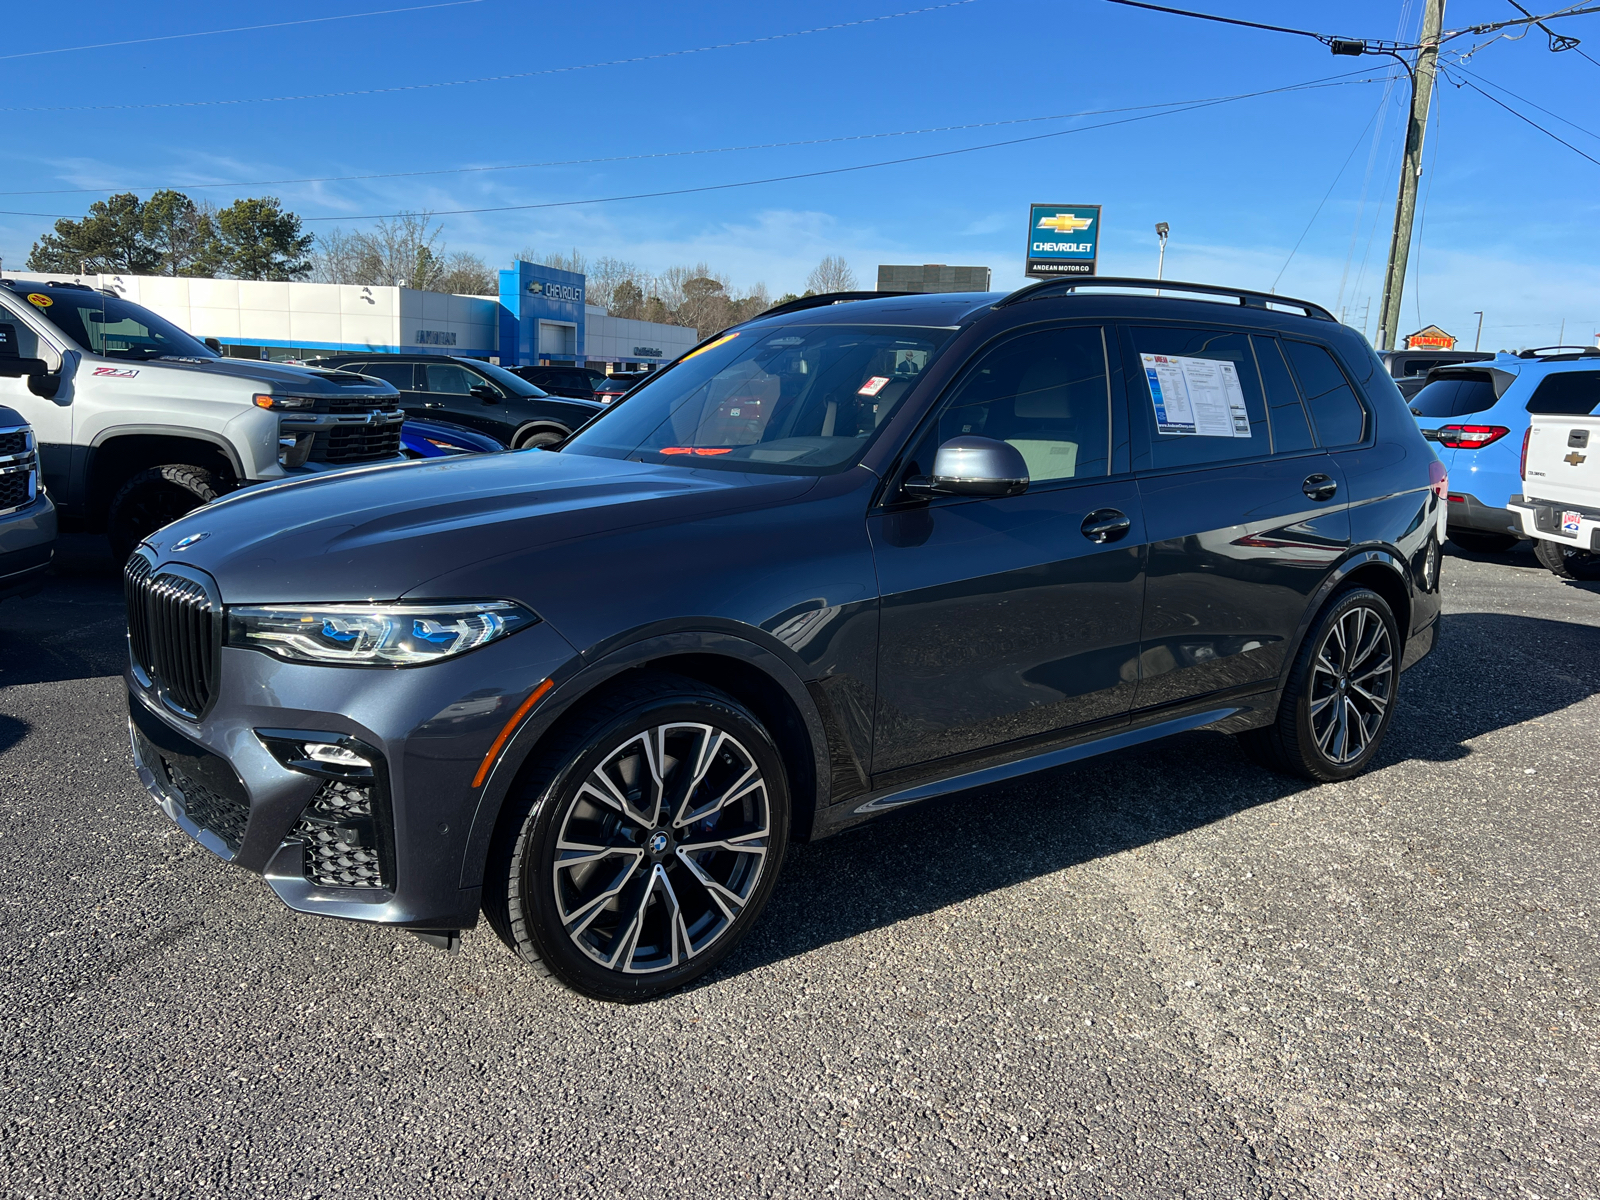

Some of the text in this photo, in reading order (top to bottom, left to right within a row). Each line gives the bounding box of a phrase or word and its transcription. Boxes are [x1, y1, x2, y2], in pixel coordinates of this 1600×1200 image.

[1033, 242, 1092, 252] CHEVROLET
[545, 283, 582, 301] CHEVROLET
[1410, 337, 1453, 347] SUMMITS
